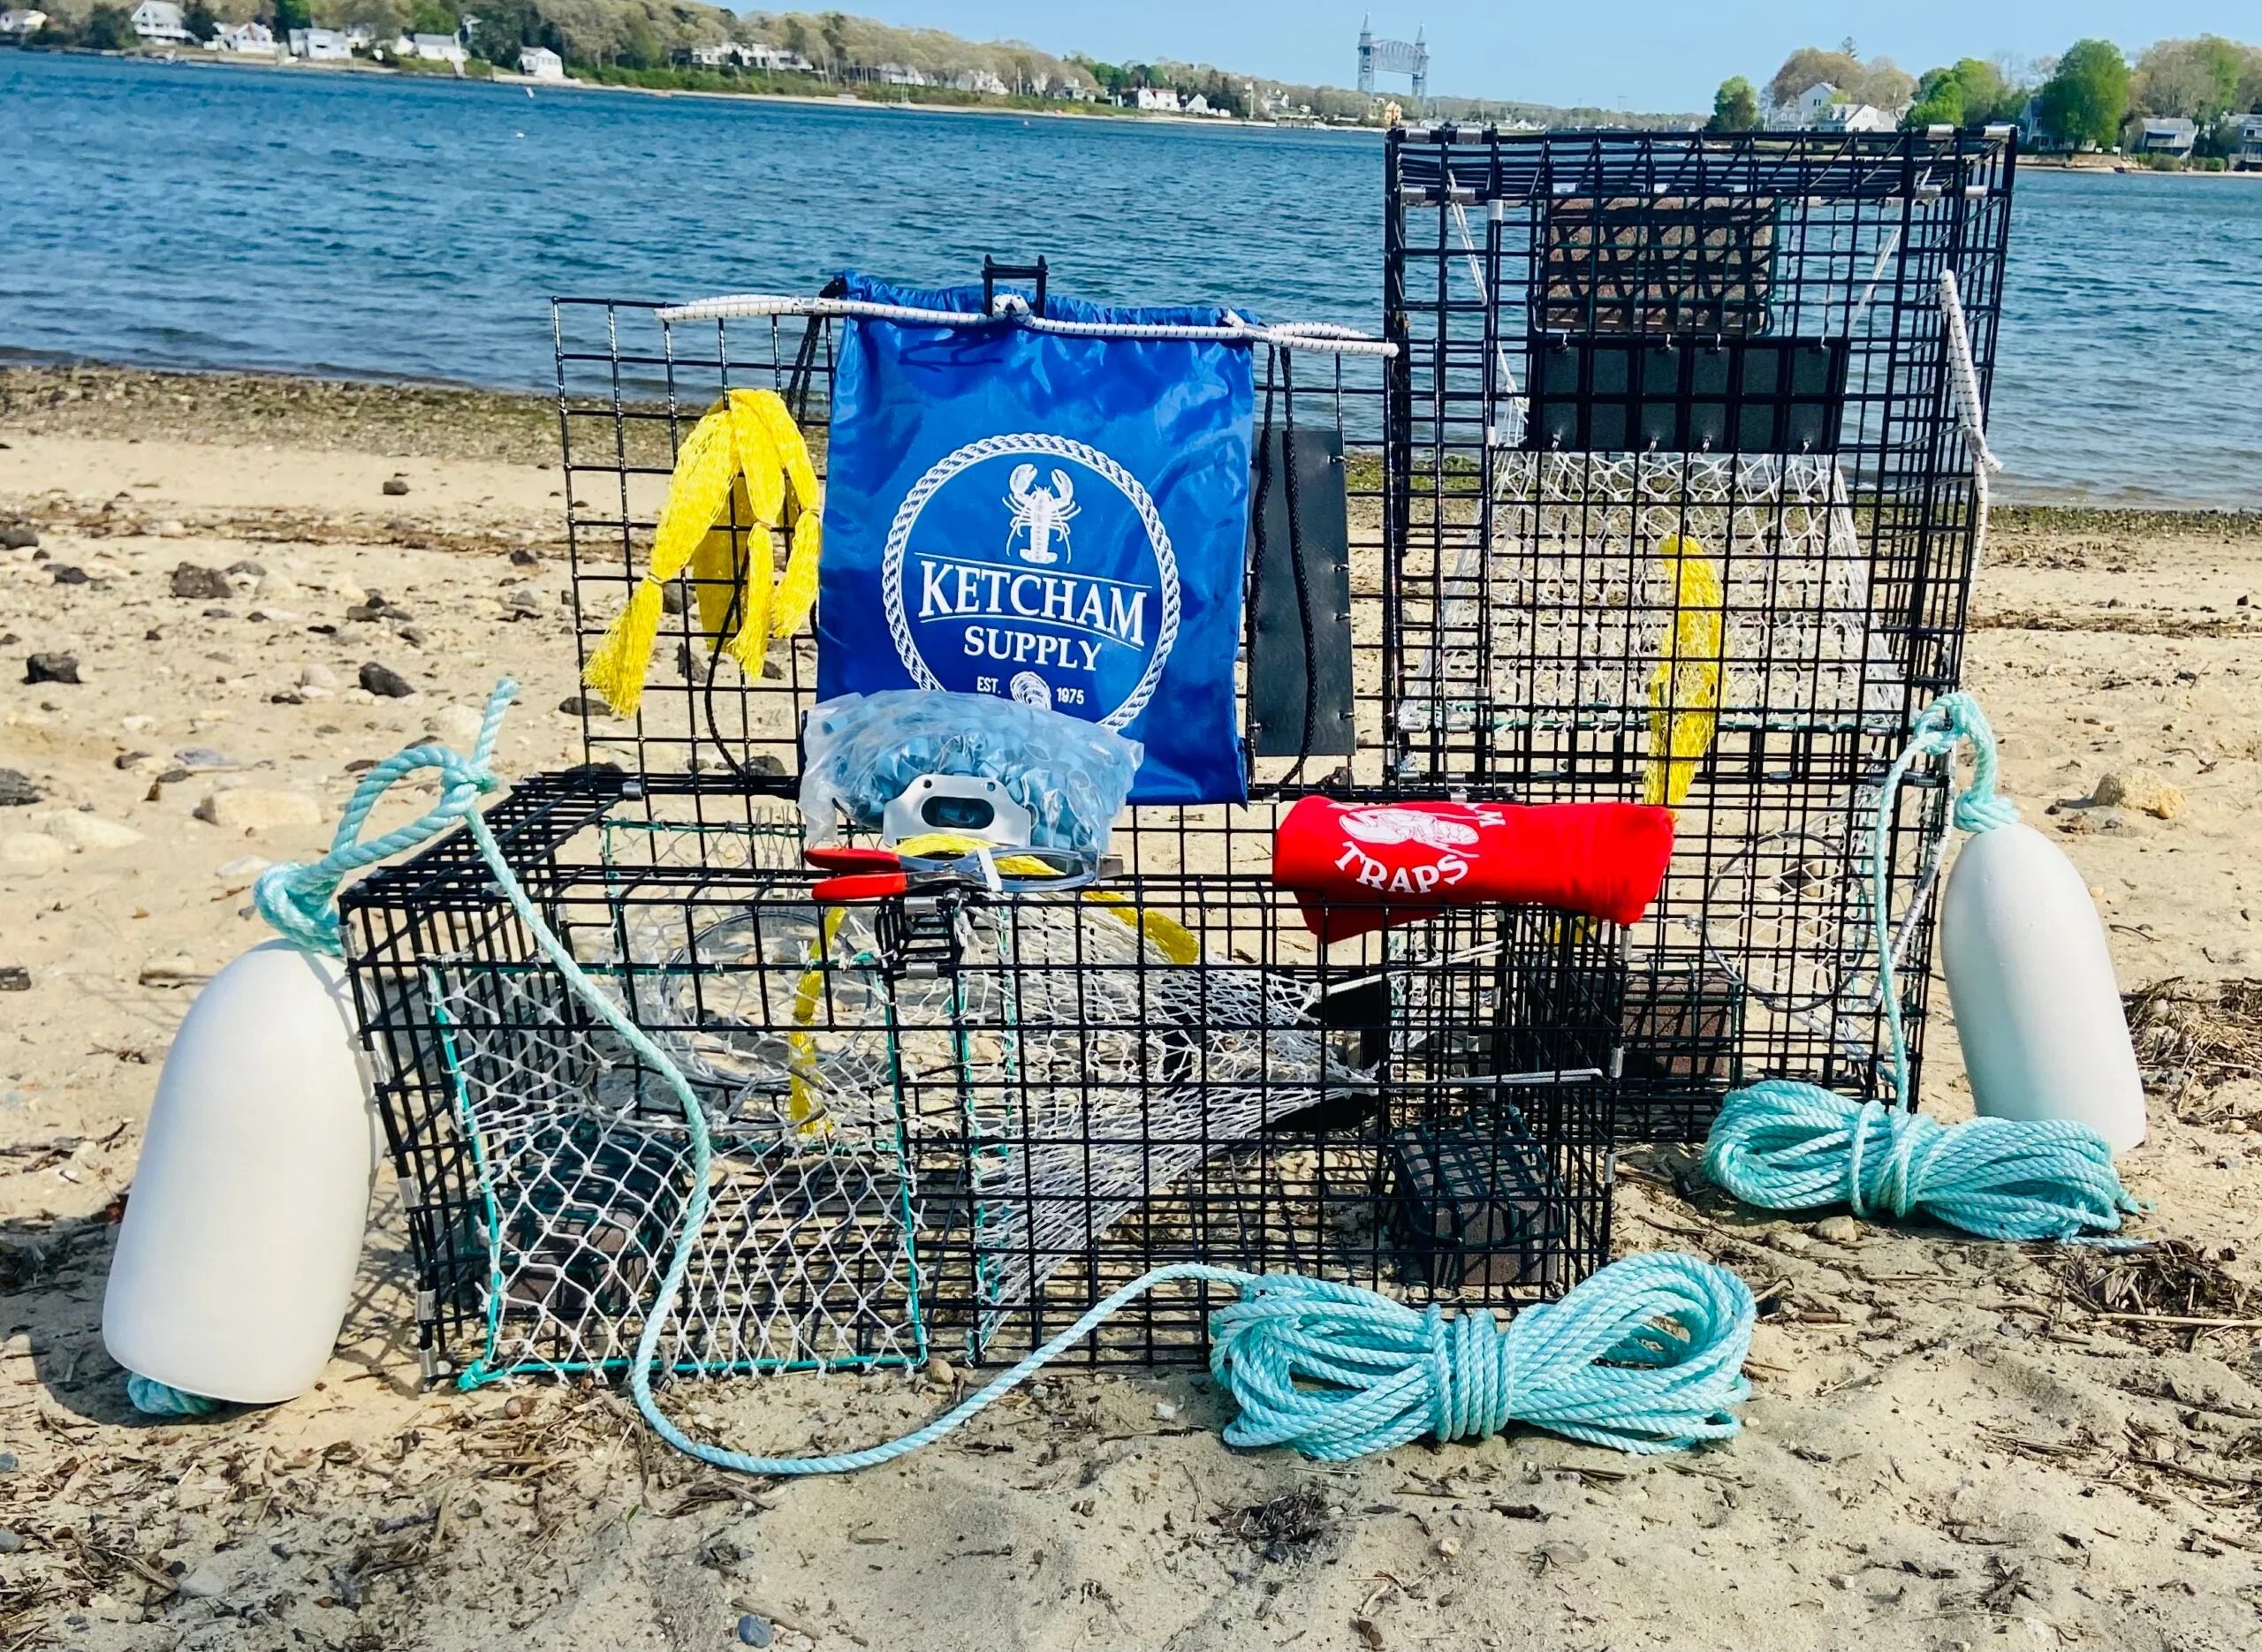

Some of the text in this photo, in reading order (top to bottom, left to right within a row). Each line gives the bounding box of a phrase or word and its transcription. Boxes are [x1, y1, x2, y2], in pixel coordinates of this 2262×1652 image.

[918, 559, 1148, 647] KETCHAM
[963, 625, 1103, 671] SUPPLY
[976, 676, 1085, 705] EST. 1975
[1333, 840, 1469, 894] TRAPS
